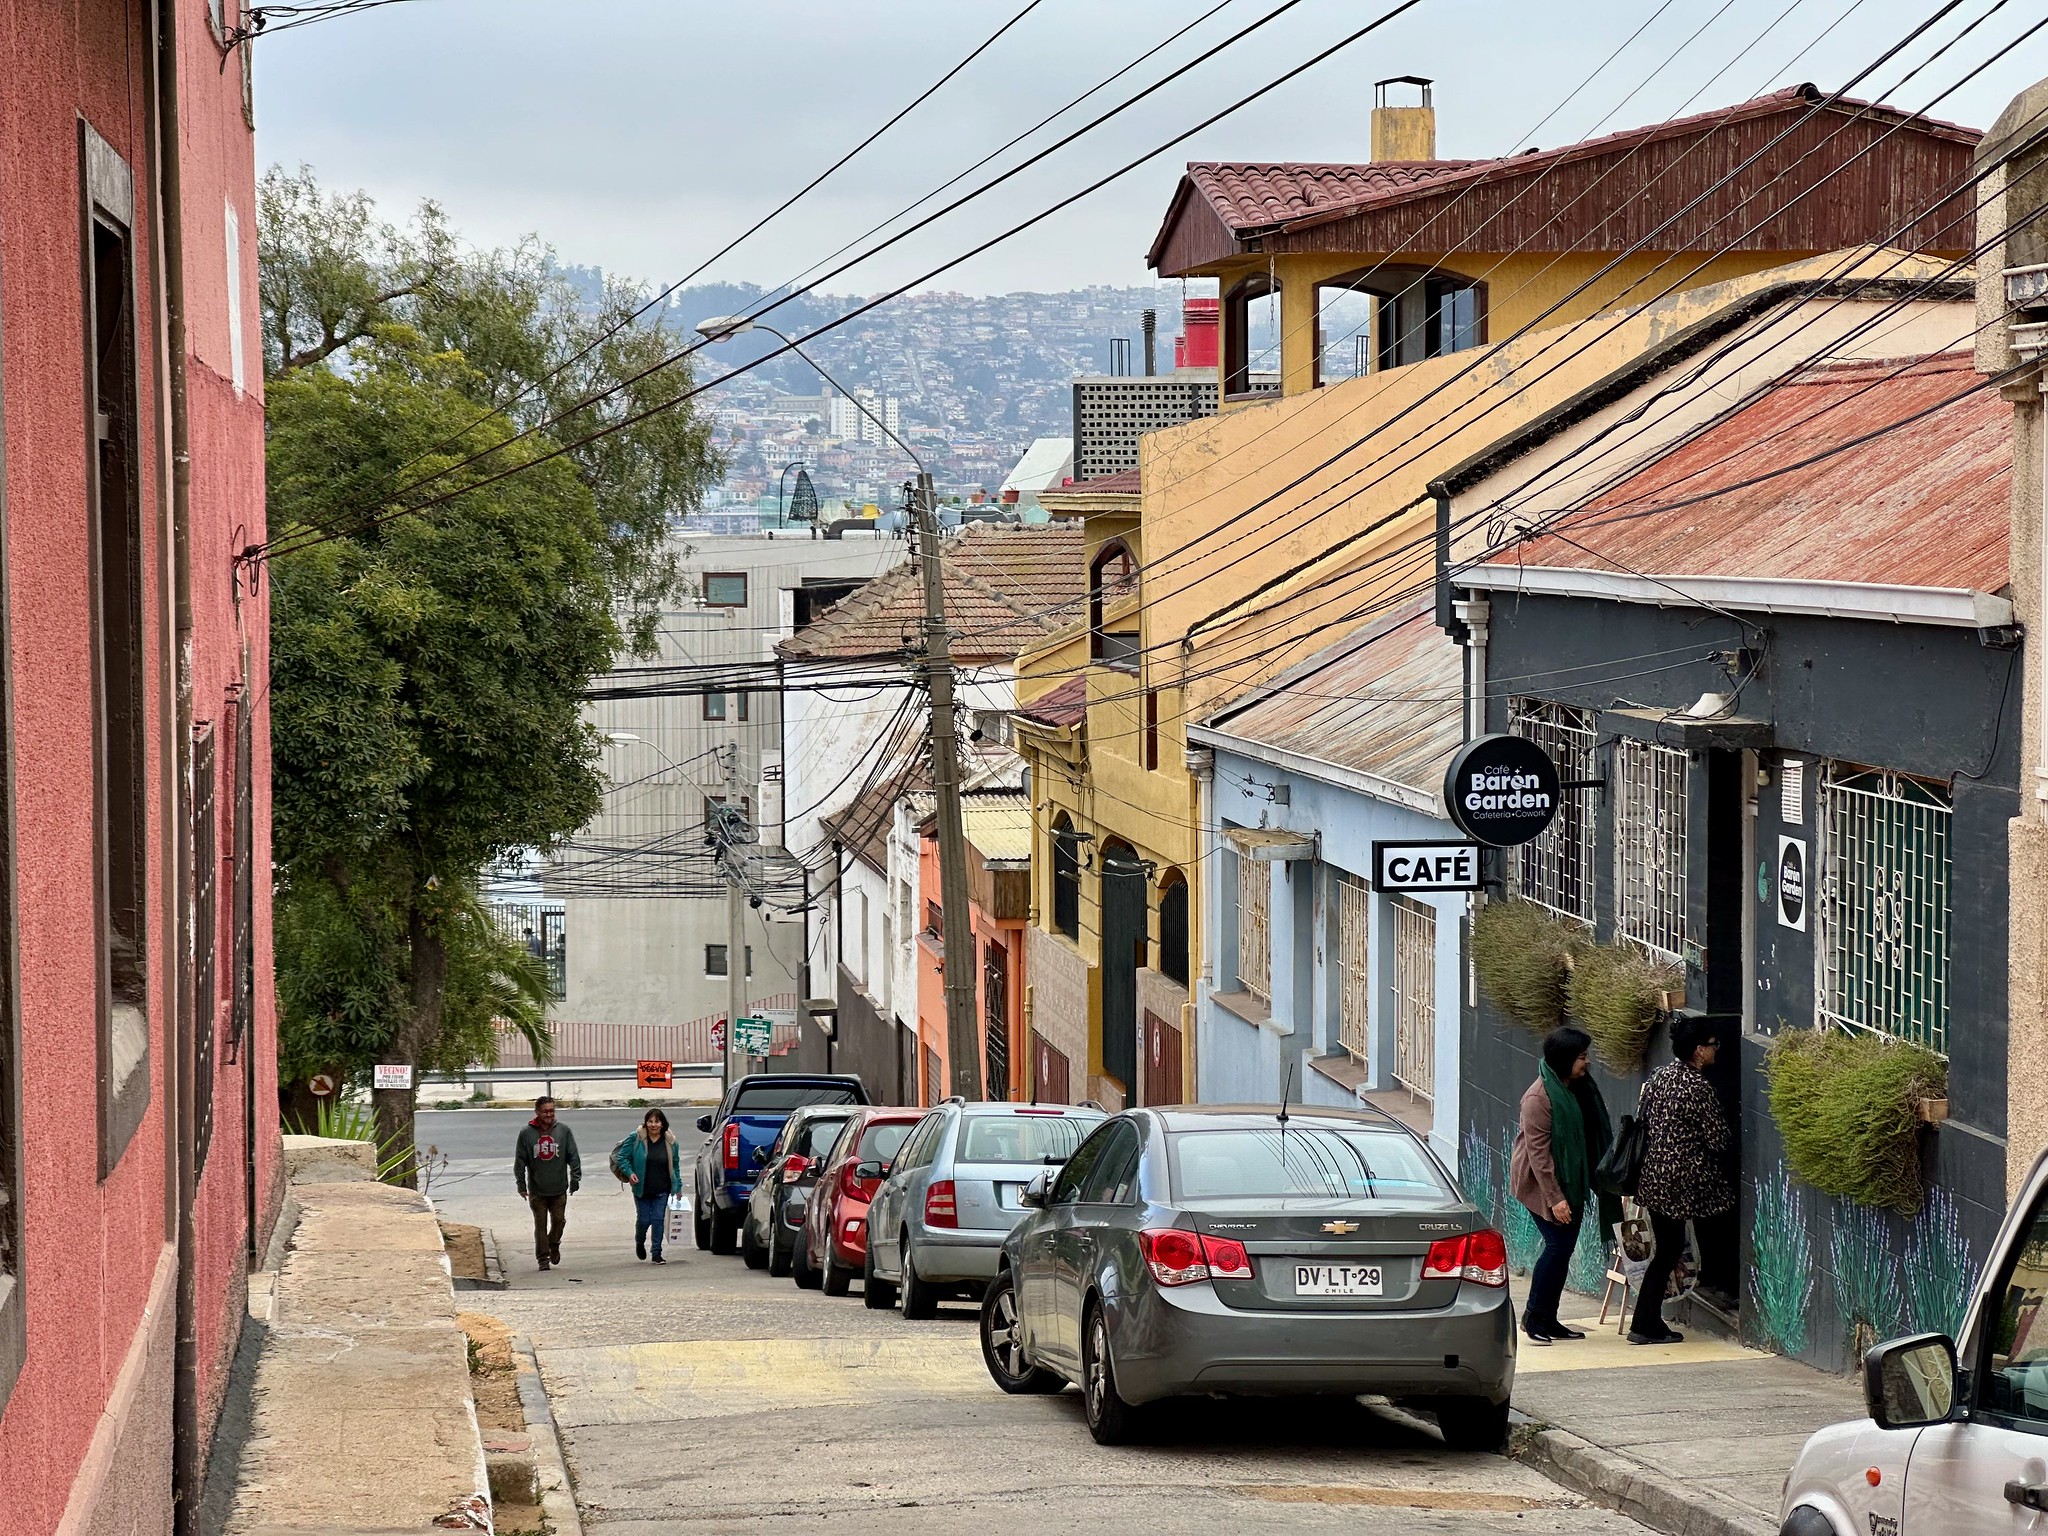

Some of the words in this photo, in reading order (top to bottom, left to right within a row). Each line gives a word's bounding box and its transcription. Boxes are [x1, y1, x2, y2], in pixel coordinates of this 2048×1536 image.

[1484, 764, 1510, 775] Café
[1465, 790, 1550, 811] Garden
[1388, 849, 1471, 883] CAFÉ
[1782, 879, 1803, 898] Garden
[1419, 1223, 1449, 1231] CRUZE
